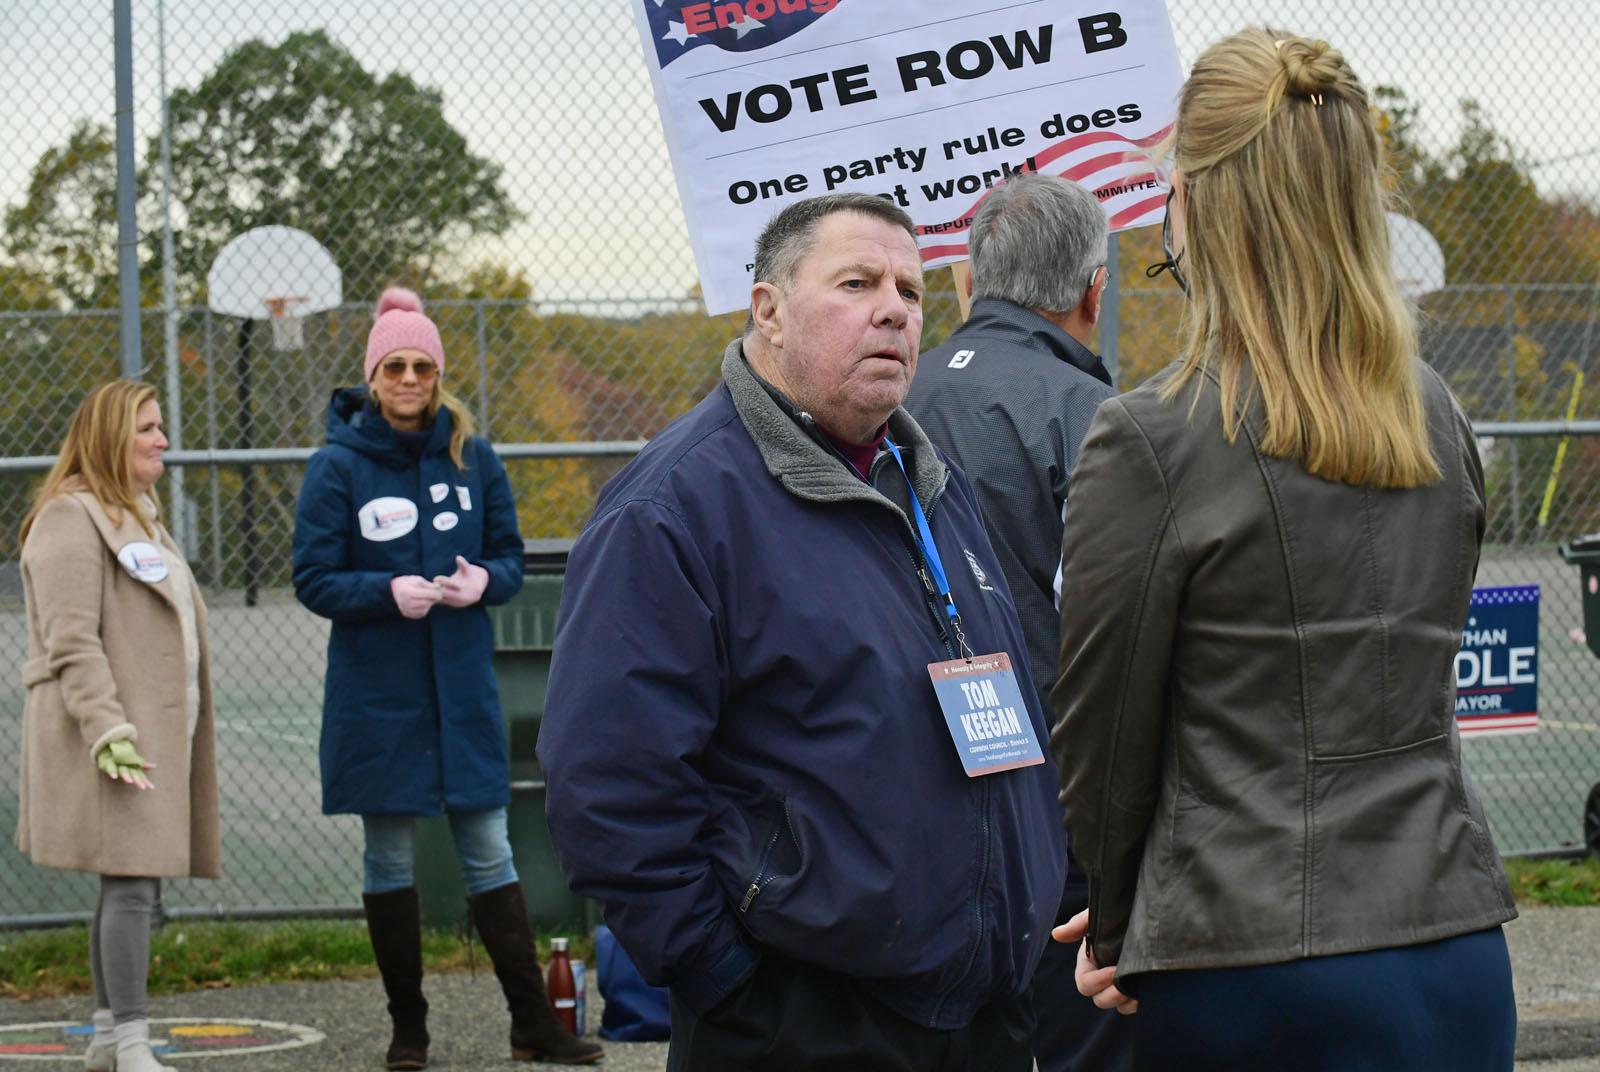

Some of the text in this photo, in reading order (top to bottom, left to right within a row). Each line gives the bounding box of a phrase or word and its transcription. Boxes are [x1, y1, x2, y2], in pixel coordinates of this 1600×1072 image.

[698, 12, 1127, 132] VOTE ROW B
[728, 103, 1142, 205] One party rule does
[1092, 179, 1159, 199] MMITTE
[1454, 647, 1535, 687] DLE
[960, 680, 1000, 710] TOM
[1455, 694, 1502, 711] AYOR
[960, 707, 1022, 742] KEEGAN
